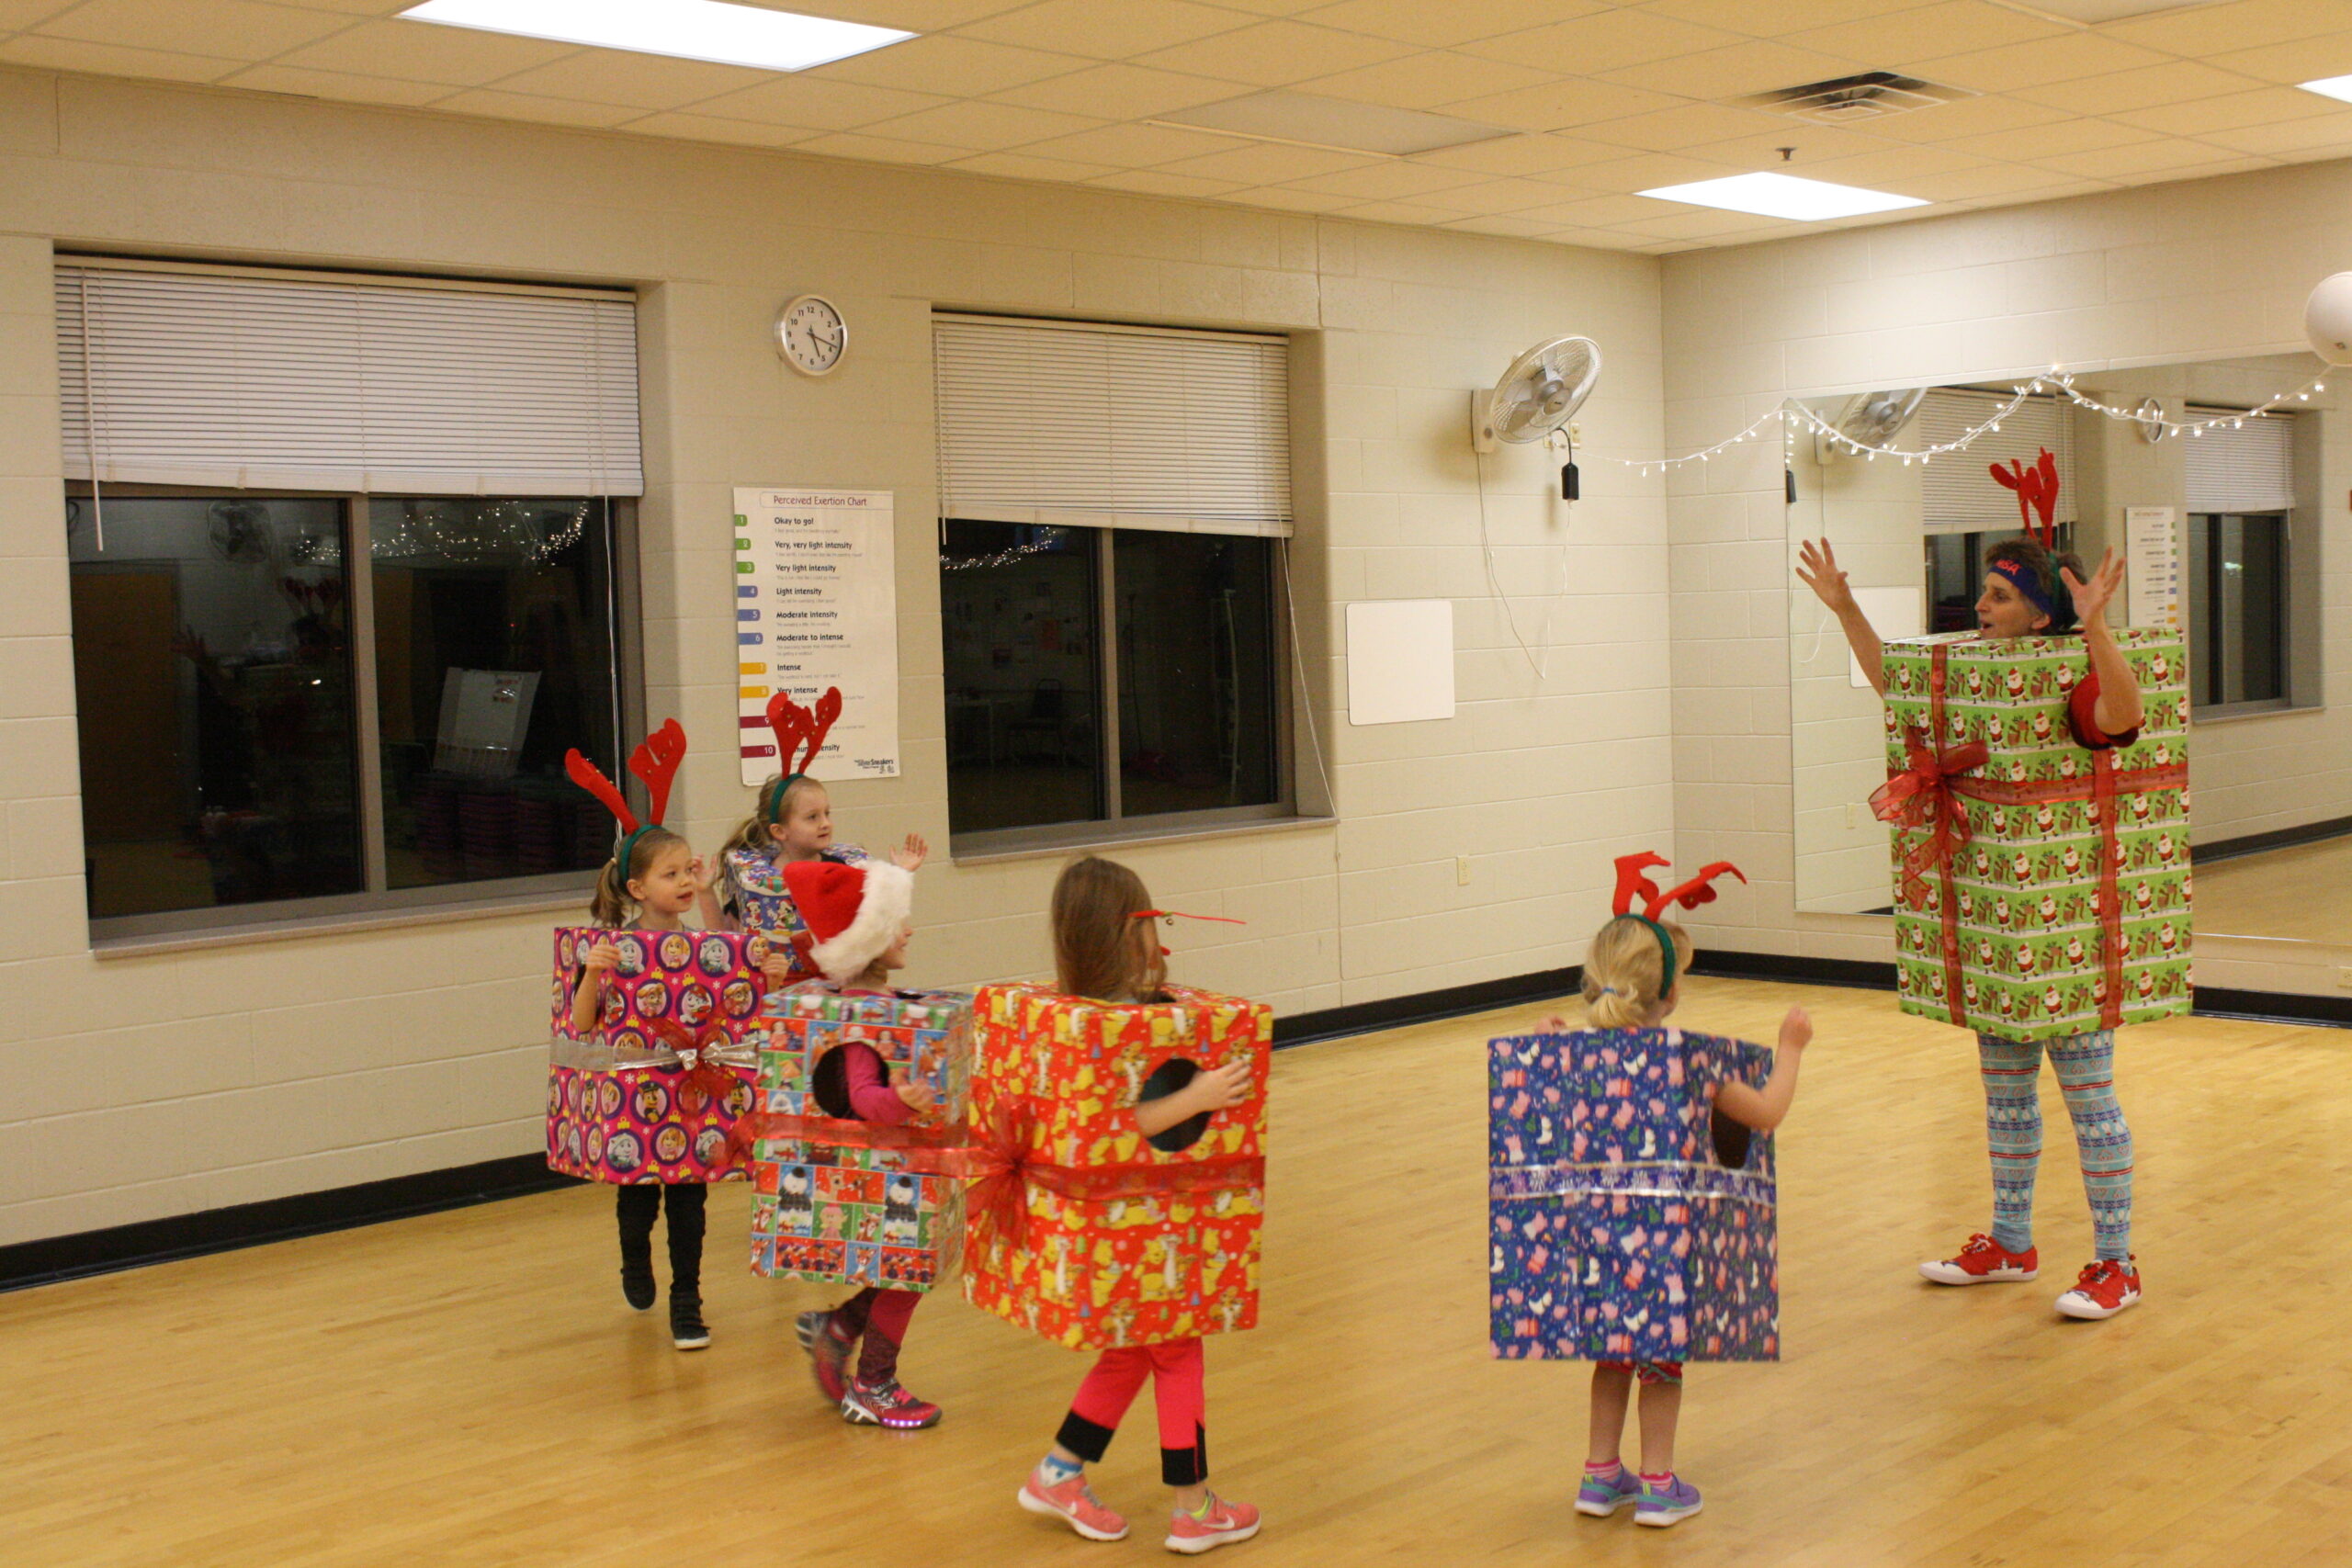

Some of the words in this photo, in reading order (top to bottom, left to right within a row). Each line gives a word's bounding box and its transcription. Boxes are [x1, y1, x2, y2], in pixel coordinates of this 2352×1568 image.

[774, 495, 812, 505] Perceived
[814, 496, 844, 505] Exertion
[847, 497, 867, 506] Chart
[775, 517, 792, 525] Okay
[775, 541, 790, 549] Very,
[825, 542, 853, 550] intensity
[775, 564, 790, 572] Very
[792, 564, 807, 573] light
[776, 588, 792, 596] Light
[810, 611, 838, 619] intensity
[777, 687, 791, 695] Very
